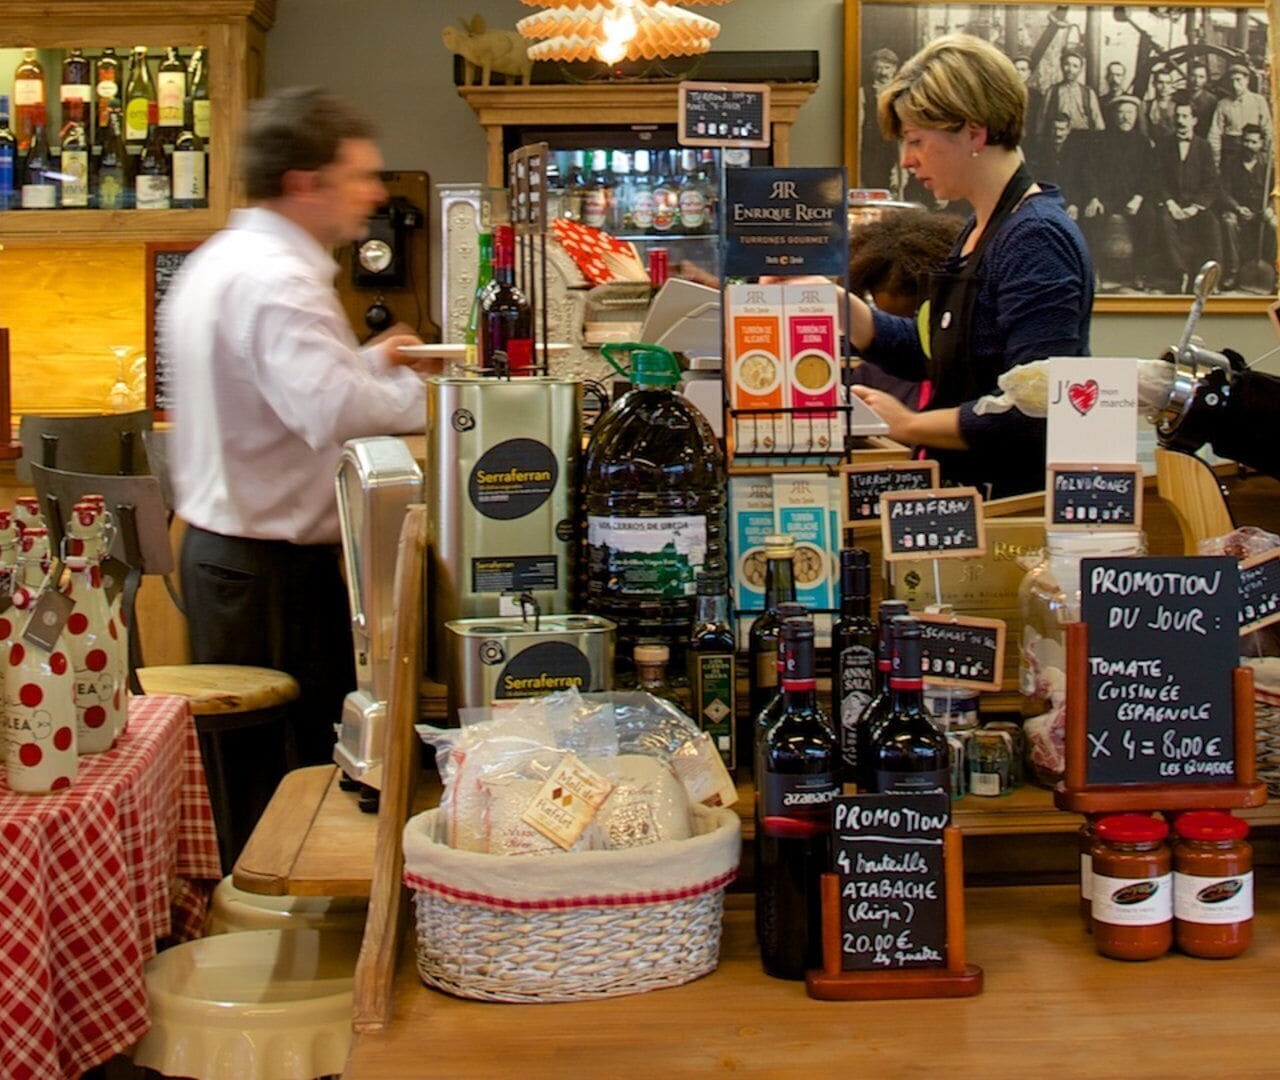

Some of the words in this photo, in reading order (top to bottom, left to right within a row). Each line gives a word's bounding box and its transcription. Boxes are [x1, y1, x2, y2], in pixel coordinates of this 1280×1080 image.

[477, 468, 551, 484] Serraferran
[891, 500, 970, 519] AZAFRAN
[1091, 567, 1221, 596] PROMOTION
[1109, 607, 1140, 629] DU
[1148, 605, 1207, 635] JOUR
[504, 673, 582, 690] Serraferran
[1117, 703, 1211, 722] ESPAGNOLE
[1122, 731, 1137, 760] 4
[835, 803, 948, 832] PROMOTION
[837, 849, 850, 875] 4
[842, 880, 937, 900] AZABACHE
